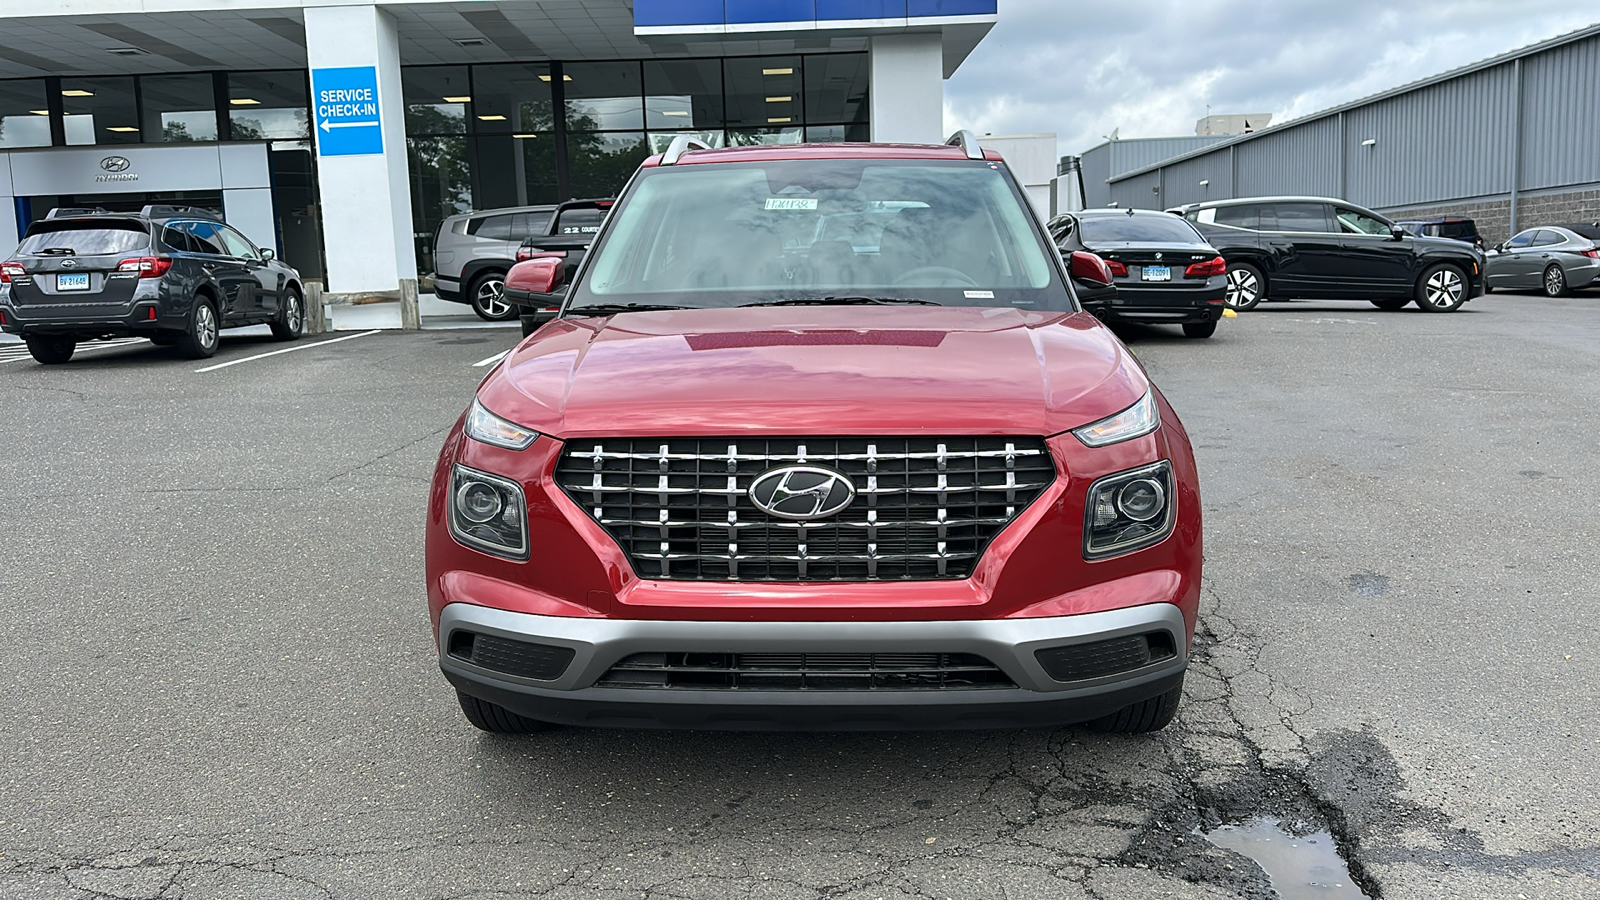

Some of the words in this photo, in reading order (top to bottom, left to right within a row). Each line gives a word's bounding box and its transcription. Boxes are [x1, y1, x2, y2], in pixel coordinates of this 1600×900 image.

[320, 88, 372, 103] SERVICE
[319, 103, 376, 117] CHECK-IN
[95, 173, 139, 182] HYUNDAI
